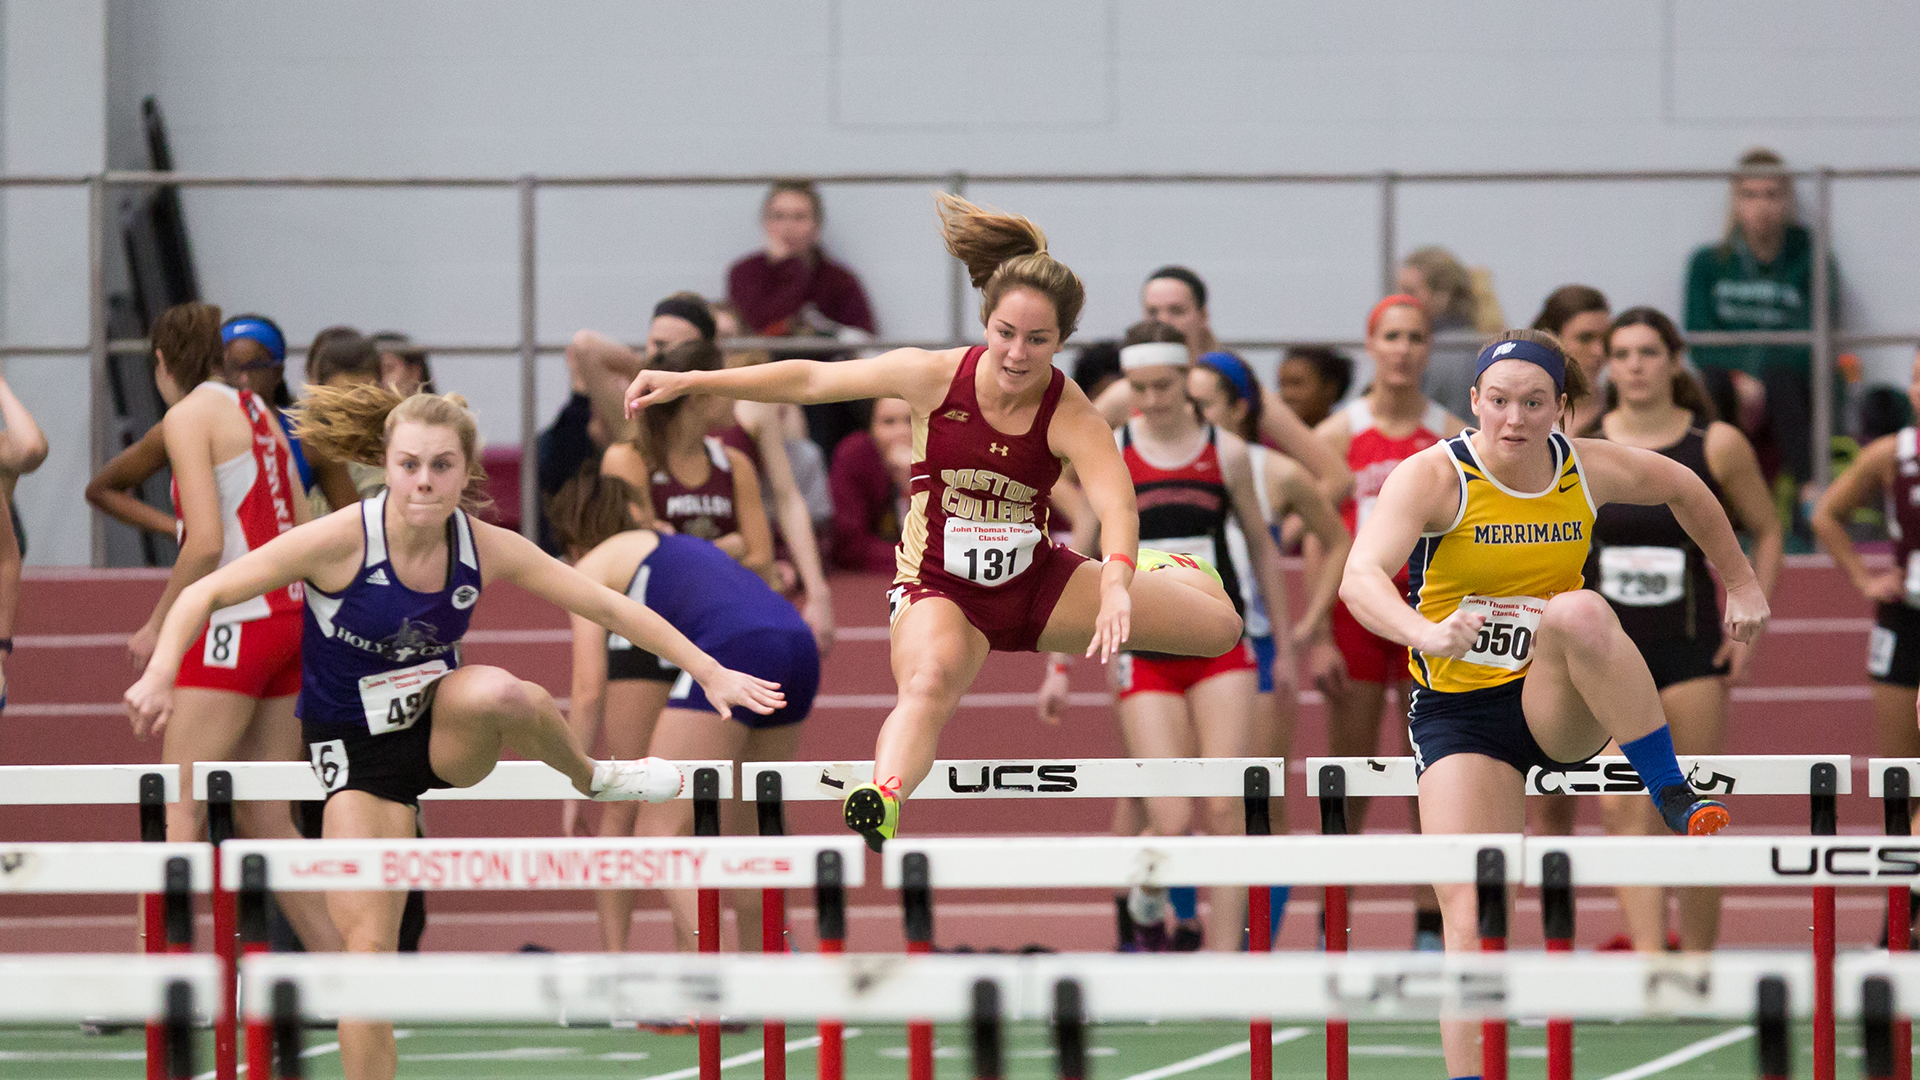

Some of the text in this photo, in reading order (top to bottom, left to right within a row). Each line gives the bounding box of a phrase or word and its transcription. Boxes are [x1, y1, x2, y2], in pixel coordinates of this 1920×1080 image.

[941, 468, 1038, 503] BOSTON
[941, 486, 1037, 523] COLLEGE
[1474, 521, 1583, 544] MERRIMACK
[964, 547, 1018, 581] 131
[1489, 600, 1520, 609] Thomas
[1522, 604, 1544, 615] Terri
[1491, 610, 1520, 619] Classic
[212, 624, 232, 661] 8
[336, 626, 384, 654] HOLY
[1471, 622, 1532, 661] 550
[320, 745, 338, 788] 6
[948, 764, 1078, 793] UCS
[290, 849, 791, 885] UCS BOSTON UNIVERSITY UCS
[1772, 847, 1920, 876] UCS
[1325, 971, 1507, 1008] UCS
